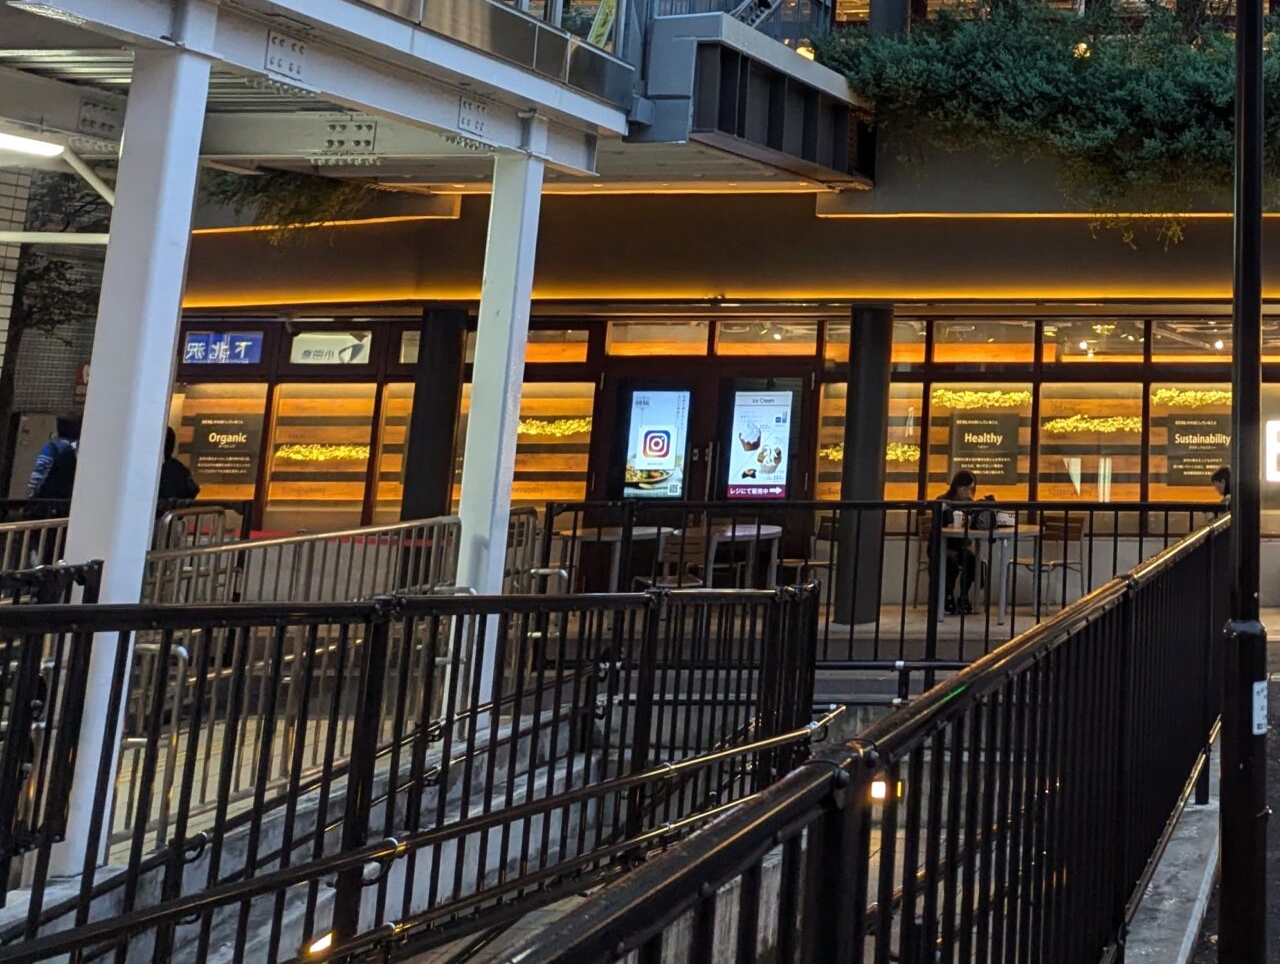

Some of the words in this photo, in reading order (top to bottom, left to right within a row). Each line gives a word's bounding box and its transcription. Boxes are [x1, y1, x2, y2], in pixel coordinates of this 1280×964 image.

[209, 432, 247, 445] Organic
[964, 432, 1003, 446] Healthy
[1174, 433, 1231, 447] Sustainability
